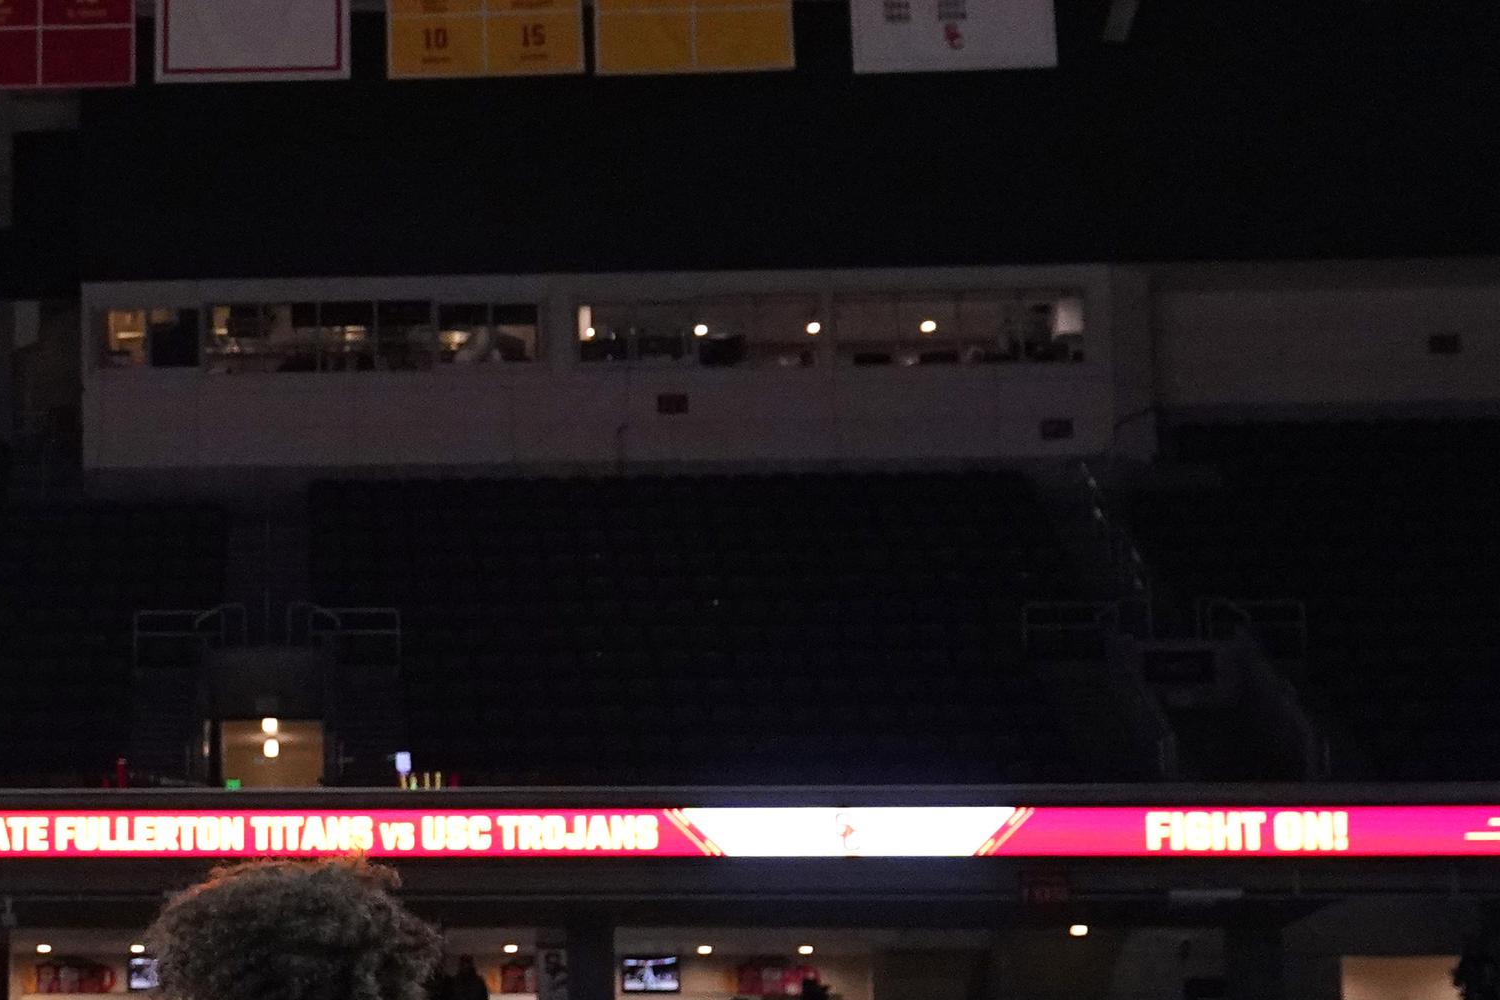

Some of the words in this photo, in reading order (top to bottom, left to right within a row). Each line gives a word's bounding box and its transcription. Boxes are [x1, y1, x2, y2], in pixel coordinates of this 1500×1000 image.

[423, 27, 449, 50] 10
[55, 816, 245, 852] FULLERTON
[250, 816, 373, 851] TITANS
[421, 815, 492, 851] USC
[497, 815, 659, 851] TROJANS
[1145, 811, 1267, 851] FIGHT
[1273, 811, 1349, 851] ON!
